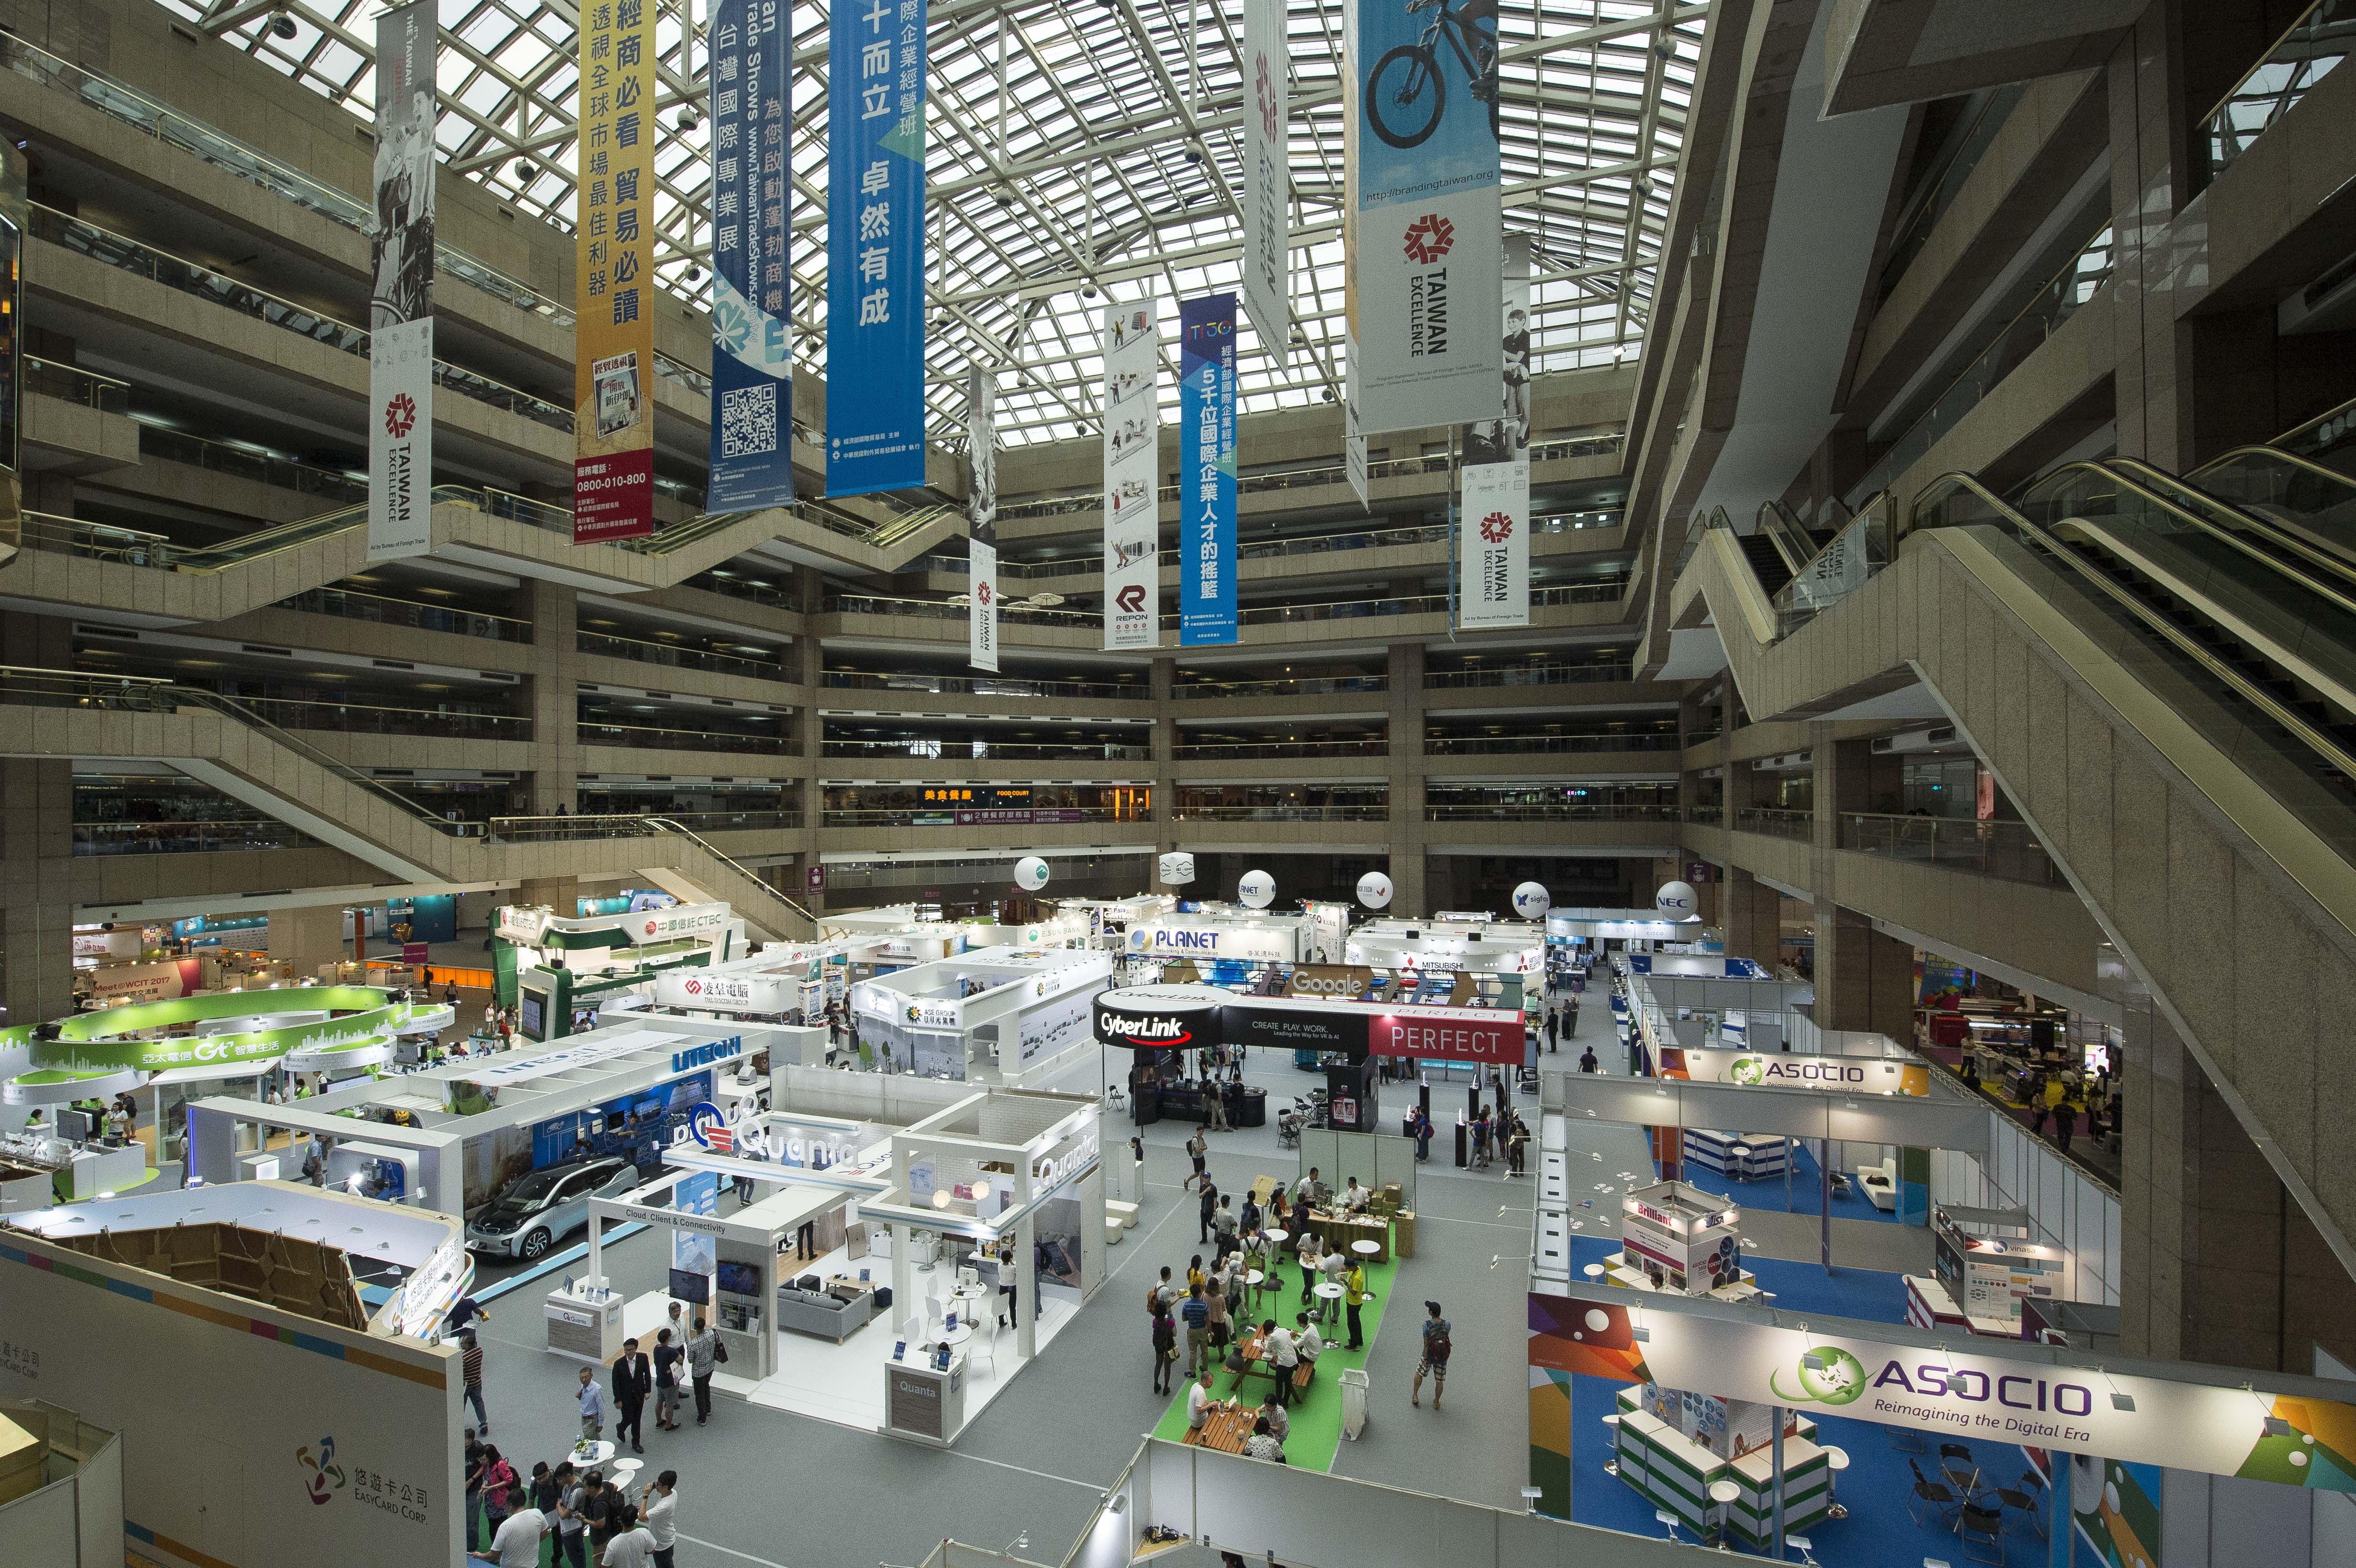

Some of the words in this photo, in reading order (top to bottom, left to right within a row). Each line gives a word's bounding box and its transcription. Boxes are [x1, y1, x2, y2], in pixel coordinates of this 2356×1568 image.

[615, 0, 642, 149] 經商必看
[748, 52, 761, 121] Shows
[899, 0, 918, 137] 際企業經營班
[589, 3, 611, 296] 透視全球市場最佳利器
[718, 23, 738, 252] 台灣國際專業展
[764, 97, 782, 311] 為您啟動蓬勃商機
[1366, 169, 1494, 202] http://brandingtaiwan.org
[613, 167, 640, 326] 貿易必讀
[748, 127, 760, 343] www.TaiwanTradeShows.com.tw
[860, 160, 890, 327] 卓然有成
[1410, 275, 1424, 358] EXCELLENCE
[1427, 267, 1448, 355] TAIWAN
[1221, 345, 1232, 464] 經濟部國際企業經營班
[388, 448, 396, 523] EXCELLENCE
[398, 442, 411, 521] TAIWAN
[577, 472, 646, 492] 0800-010-800
[1200, 369, 1218, 599] 5千位國際企業人才的搖籃
[1484, 550, 1493, 602] EXCELLENCE
[1494, 546, 1508, 601] TAIWAN
[925, 790, 971, 800] 美食餐廳
[1530, 895, 1549, 904] sigfox
[1658, 896, 1688, 908] NEC
[658, 917, 696, 932] 中國信託
[697, 914, 721, 926] CTBC
[1041, 929, 1061, 937] E.SUN
[1063, 927, 1080, 936] BANK
[1156, 929, 1219, 949] PLANET
[150, 977, 170, 985] 2017
[1292, 971, 1363, 997] Google
[1101, 1012, 1183, 1038] CyberLink
[1252, 1021, 1279, 1030] CREATE
[1283, 1023, 1301, 1031] PLAY.
[1303, 1024, 1329, 1033] WORK.
[1397, 1009, 1501, 1018] PERFECT
[142, 1052, 192, 1064] 亞太電信
[234, 1040, 280, 1056] 智慧生活
[672, 1034, 742, 1073] LITEON
[1392, 1026, 1501, 1054] PERFECT
[1765, 1062, 1864, 1082] ASOCIO
[737, 1117, 858, 1168] Quanta
[1038, 1133, 1096, 1190] Quanta
[650, 1213, 671, 1225] Client
[679, 1218, 726, 1235] Connectivity
[1637, 1203, 1672, 1227] Brilliant
[2010, 1245, 2036, 1254] vinasa
[570, 1316, 586, 1324] Quanta
[899, 1381, 936, 1398] Quanta
[1872, 1360, 2092, 1416] ASOCIO
[1874, 1399, 1970, 1426] Reimagining
[1974, 1413, 2000, 1429] the
[2005, 1418, 2059, 1437] Digital
[2063, 1426, 2091, 1442] Era
[354, 1466, 428, 1509] 悠遊卡公司
